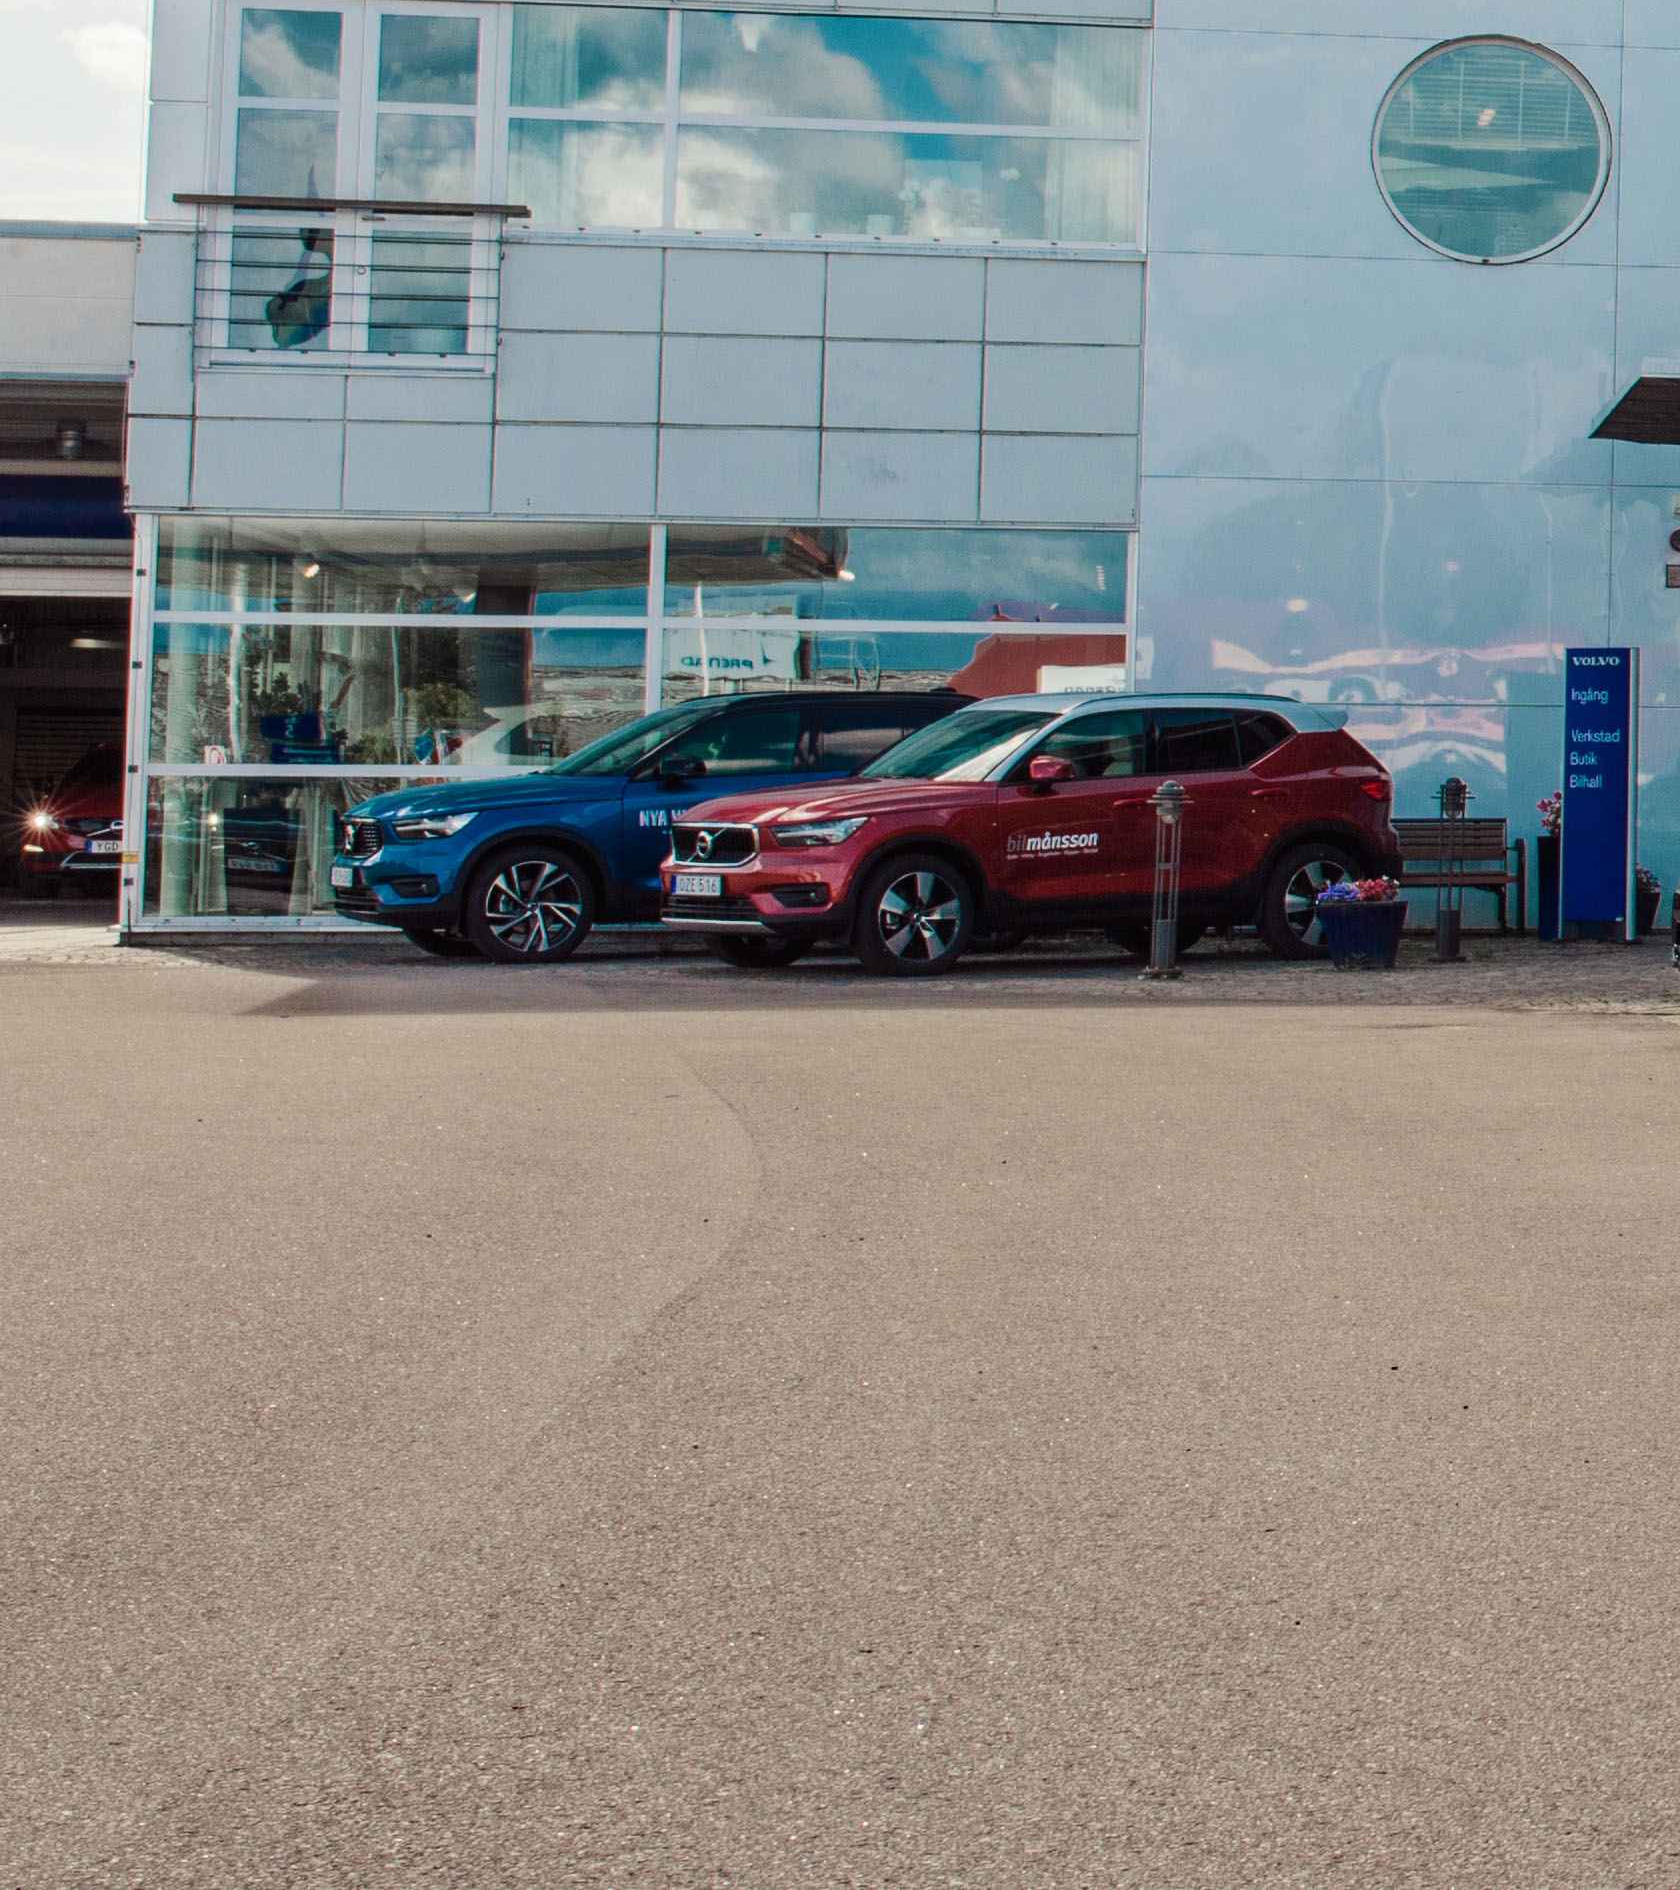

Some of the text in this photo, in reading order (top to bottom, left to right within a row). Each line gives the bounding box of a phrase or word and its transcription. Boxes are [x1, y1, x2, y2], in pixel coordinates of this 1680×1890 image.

[1571, 656, 1620, 666] VOLVO
[1571, 688, 1609, 704] Ingång
[1571, 729, 1621, 743] Verkstad
[1570, 752, 1598, 766] Butik
[1569, 775, 1602, 789] Bilhall
[640, 810, 668, 826] NYA
